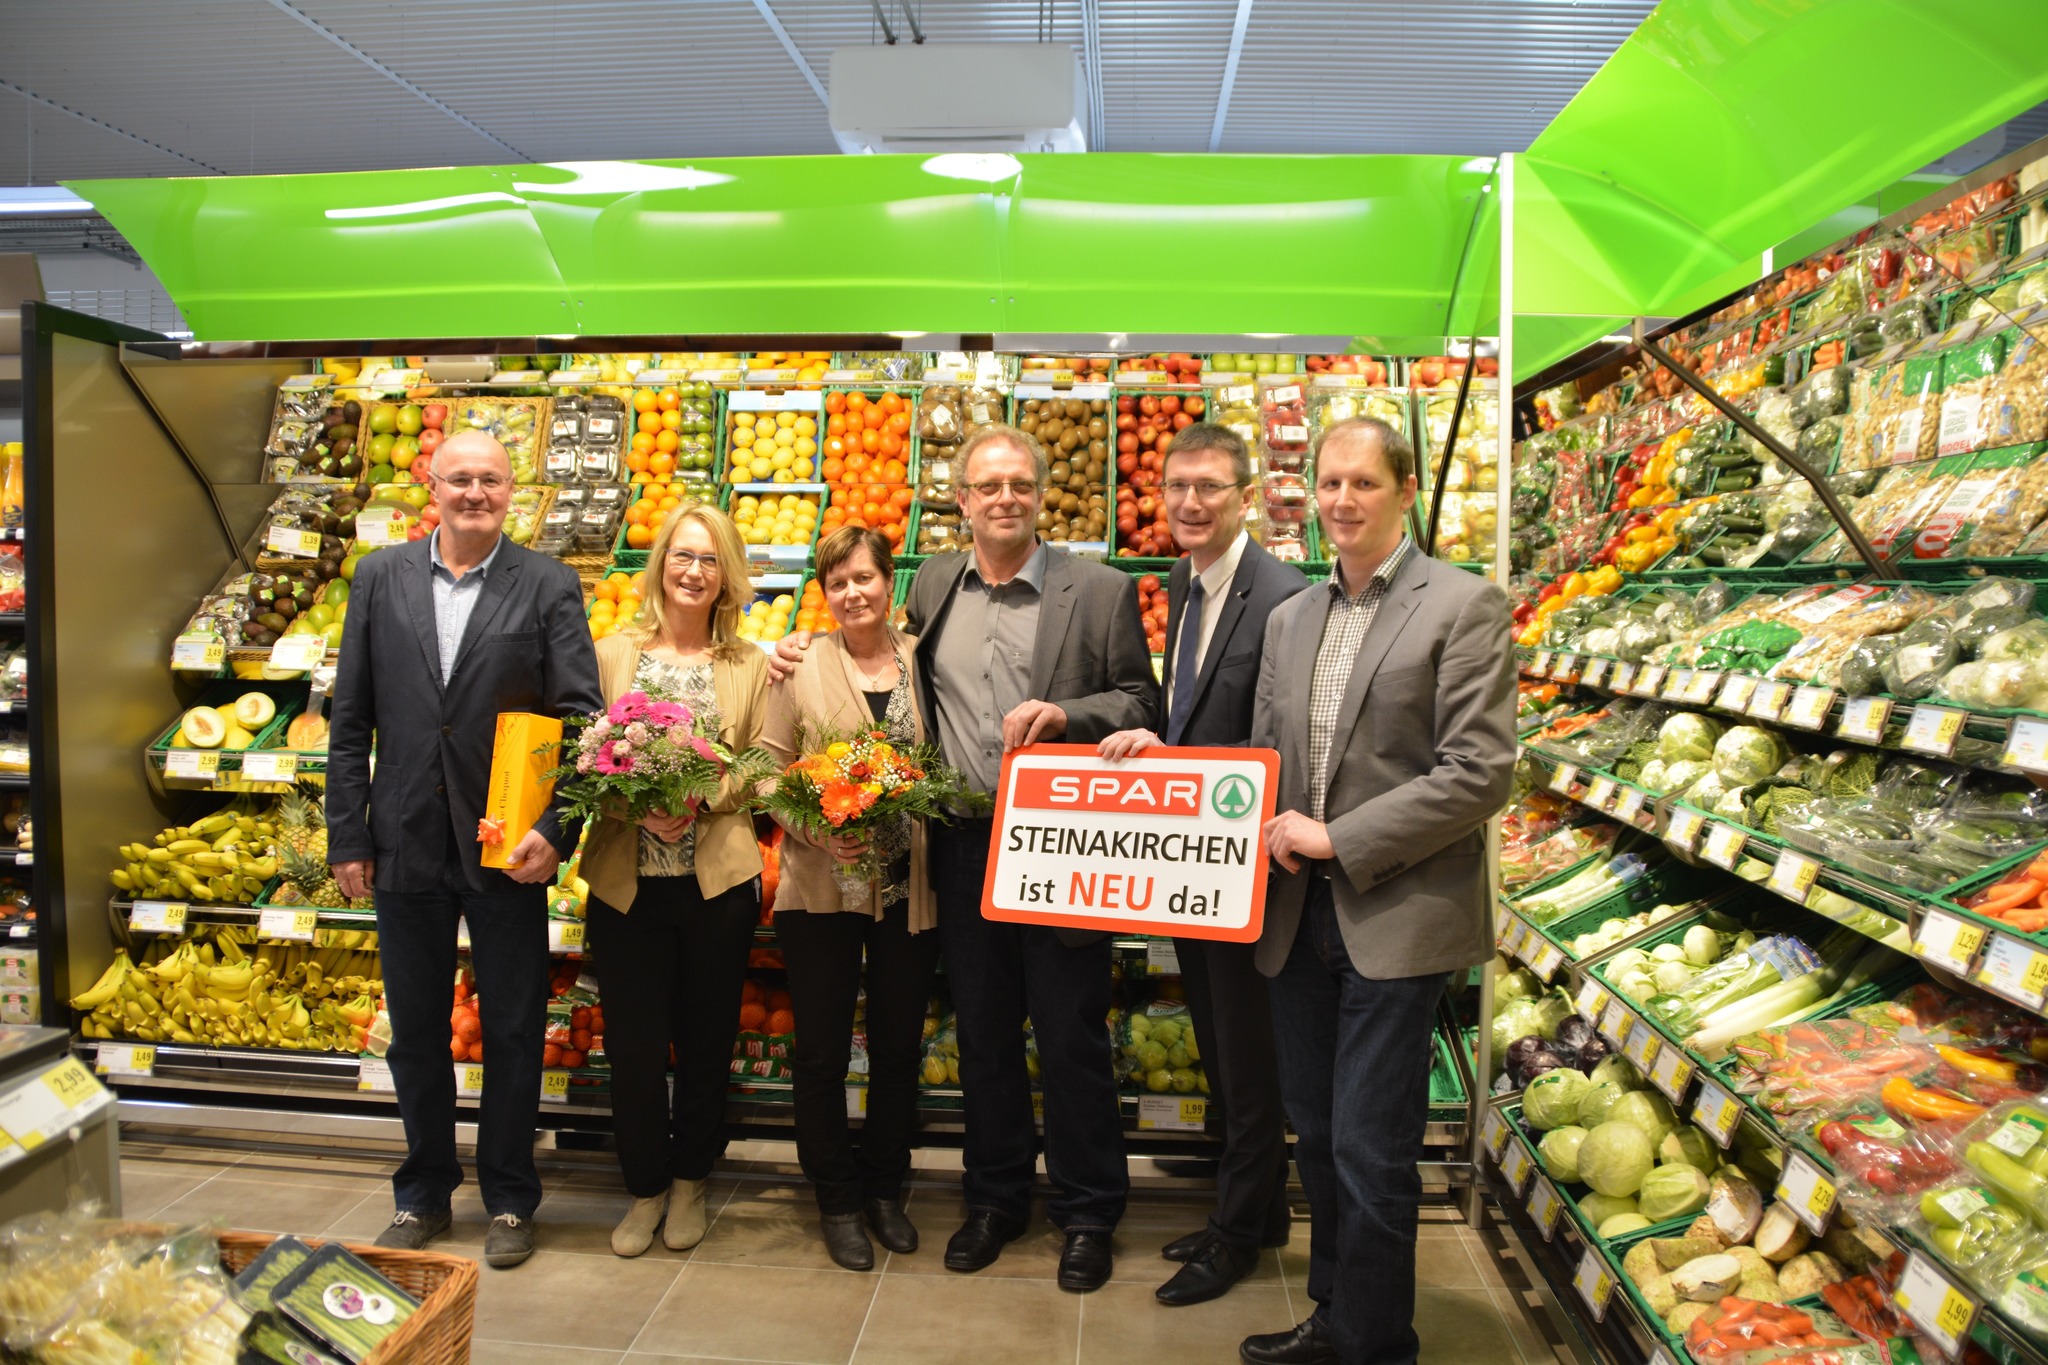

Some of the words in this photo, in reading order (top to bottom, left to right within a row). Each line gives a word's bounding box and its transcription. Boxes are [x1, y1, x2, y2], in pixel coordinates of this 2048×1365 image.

[303, 535, 318, 545] 1,39
[207, 648, 222, 658] 3,49
[201, 756, 217, 766] 2,99
[279, 759, 294, 768] 2,99
[1049, 776, 1198, 808] SPAR
[1008, 825, 1248, 866] STEINAKIRCHEN
[1019, 874, 1056, 904] ist
[1068, 871, 1154, 911] NEU
[1168, 886, 1221, 917] da!
[168, 908, 184, 919] 2,49
[297, 916, 313, 926] 2,49
[566, 928, 581, 938] 1,49
[136, 1052, 152, 1062] 1,49
[53, 1067, 86, 1094] 2,99
[548, 1076, 566, 1087] 2,49
[1185, 1103, 1203, 1116] 1,99
[1814, 1186, 1832, 1207] 2,79
[1946, 1298, 1968, 1325] 1,99
